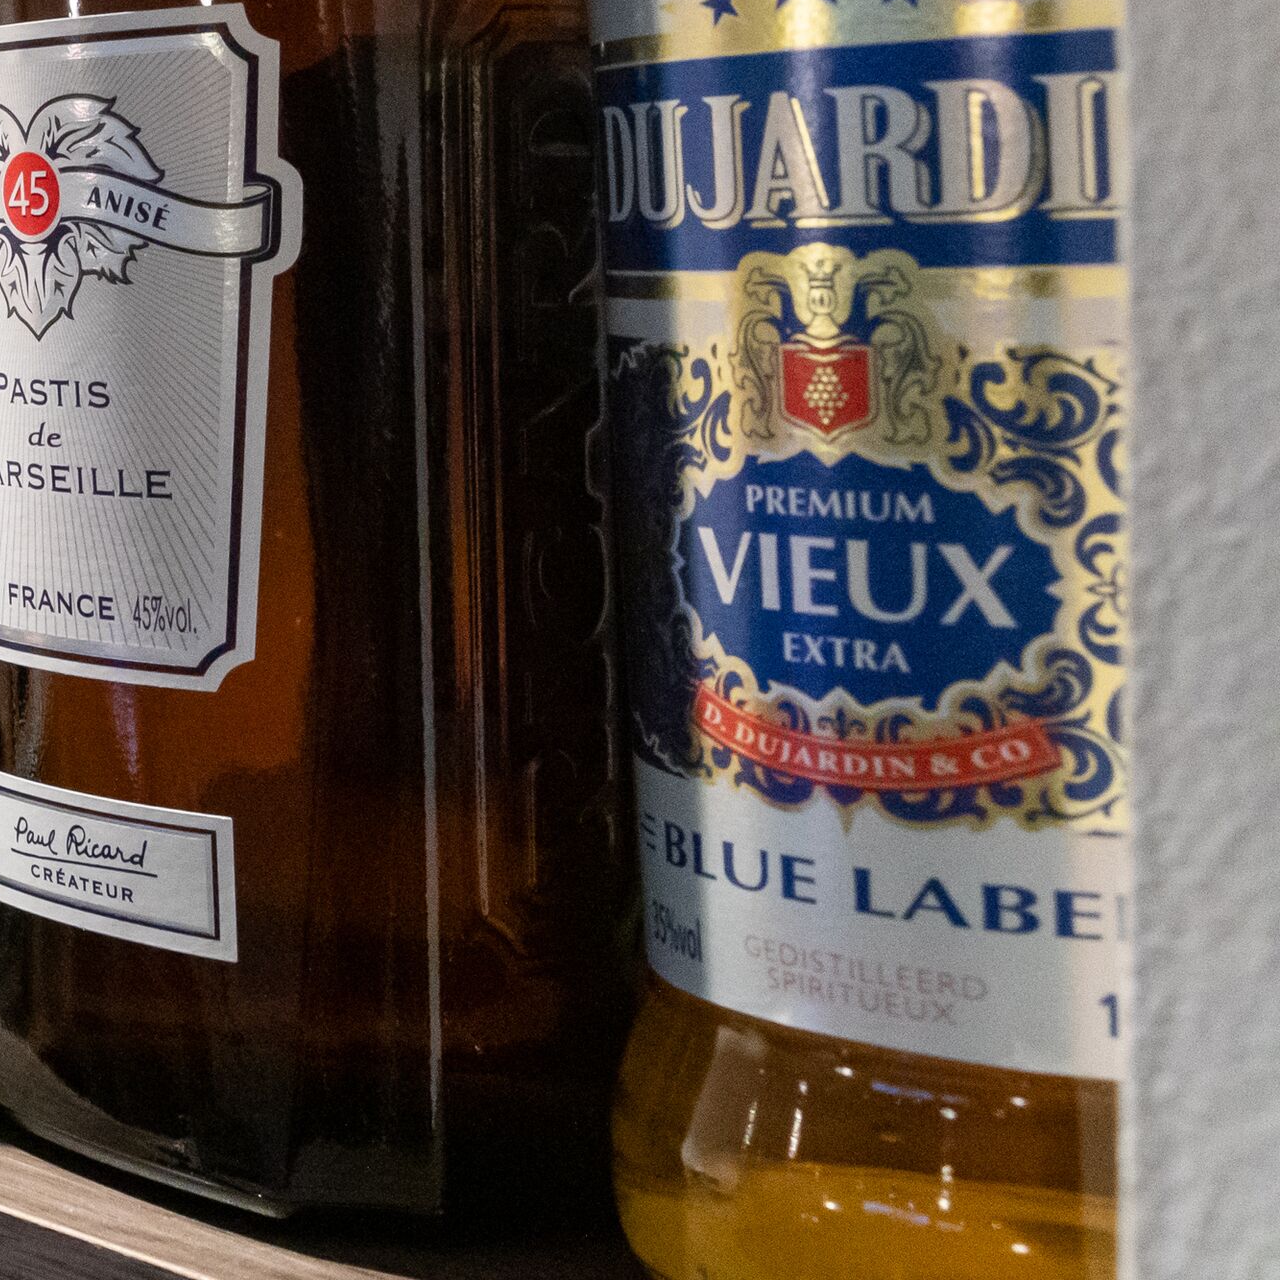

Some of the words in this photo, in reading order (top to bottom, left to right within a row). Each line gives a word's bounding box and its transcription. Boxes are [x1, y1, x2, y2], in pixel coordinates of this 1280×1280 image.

[7, 170, 50, 217] 45
[86, 186, 171, 232] ANISÉ
[28, 422, 63, 449] de
[745, 483, 936, 524] PREMIUM
[8, 582, 116, 621] FRANCE
[698, 526, 1020, 630] VIEUX
[783, 631, 911, 675] EXTRA
[734, 722, 917, 780] DUJARDIN
[931, 757, 961, 776] &
[970, 738, 1032, 765] CO
[13, 816, 58, 855] Paul
[66, 824, 148, 868] Ricard
[664, 819, 817, 905] BLUE
[30, 864, 134, 903] CRÉATEUR
[744, 932, 990, 1003] GEDISTILLEERD
[766, 966, 956, 1021] SPIRITUEUX
